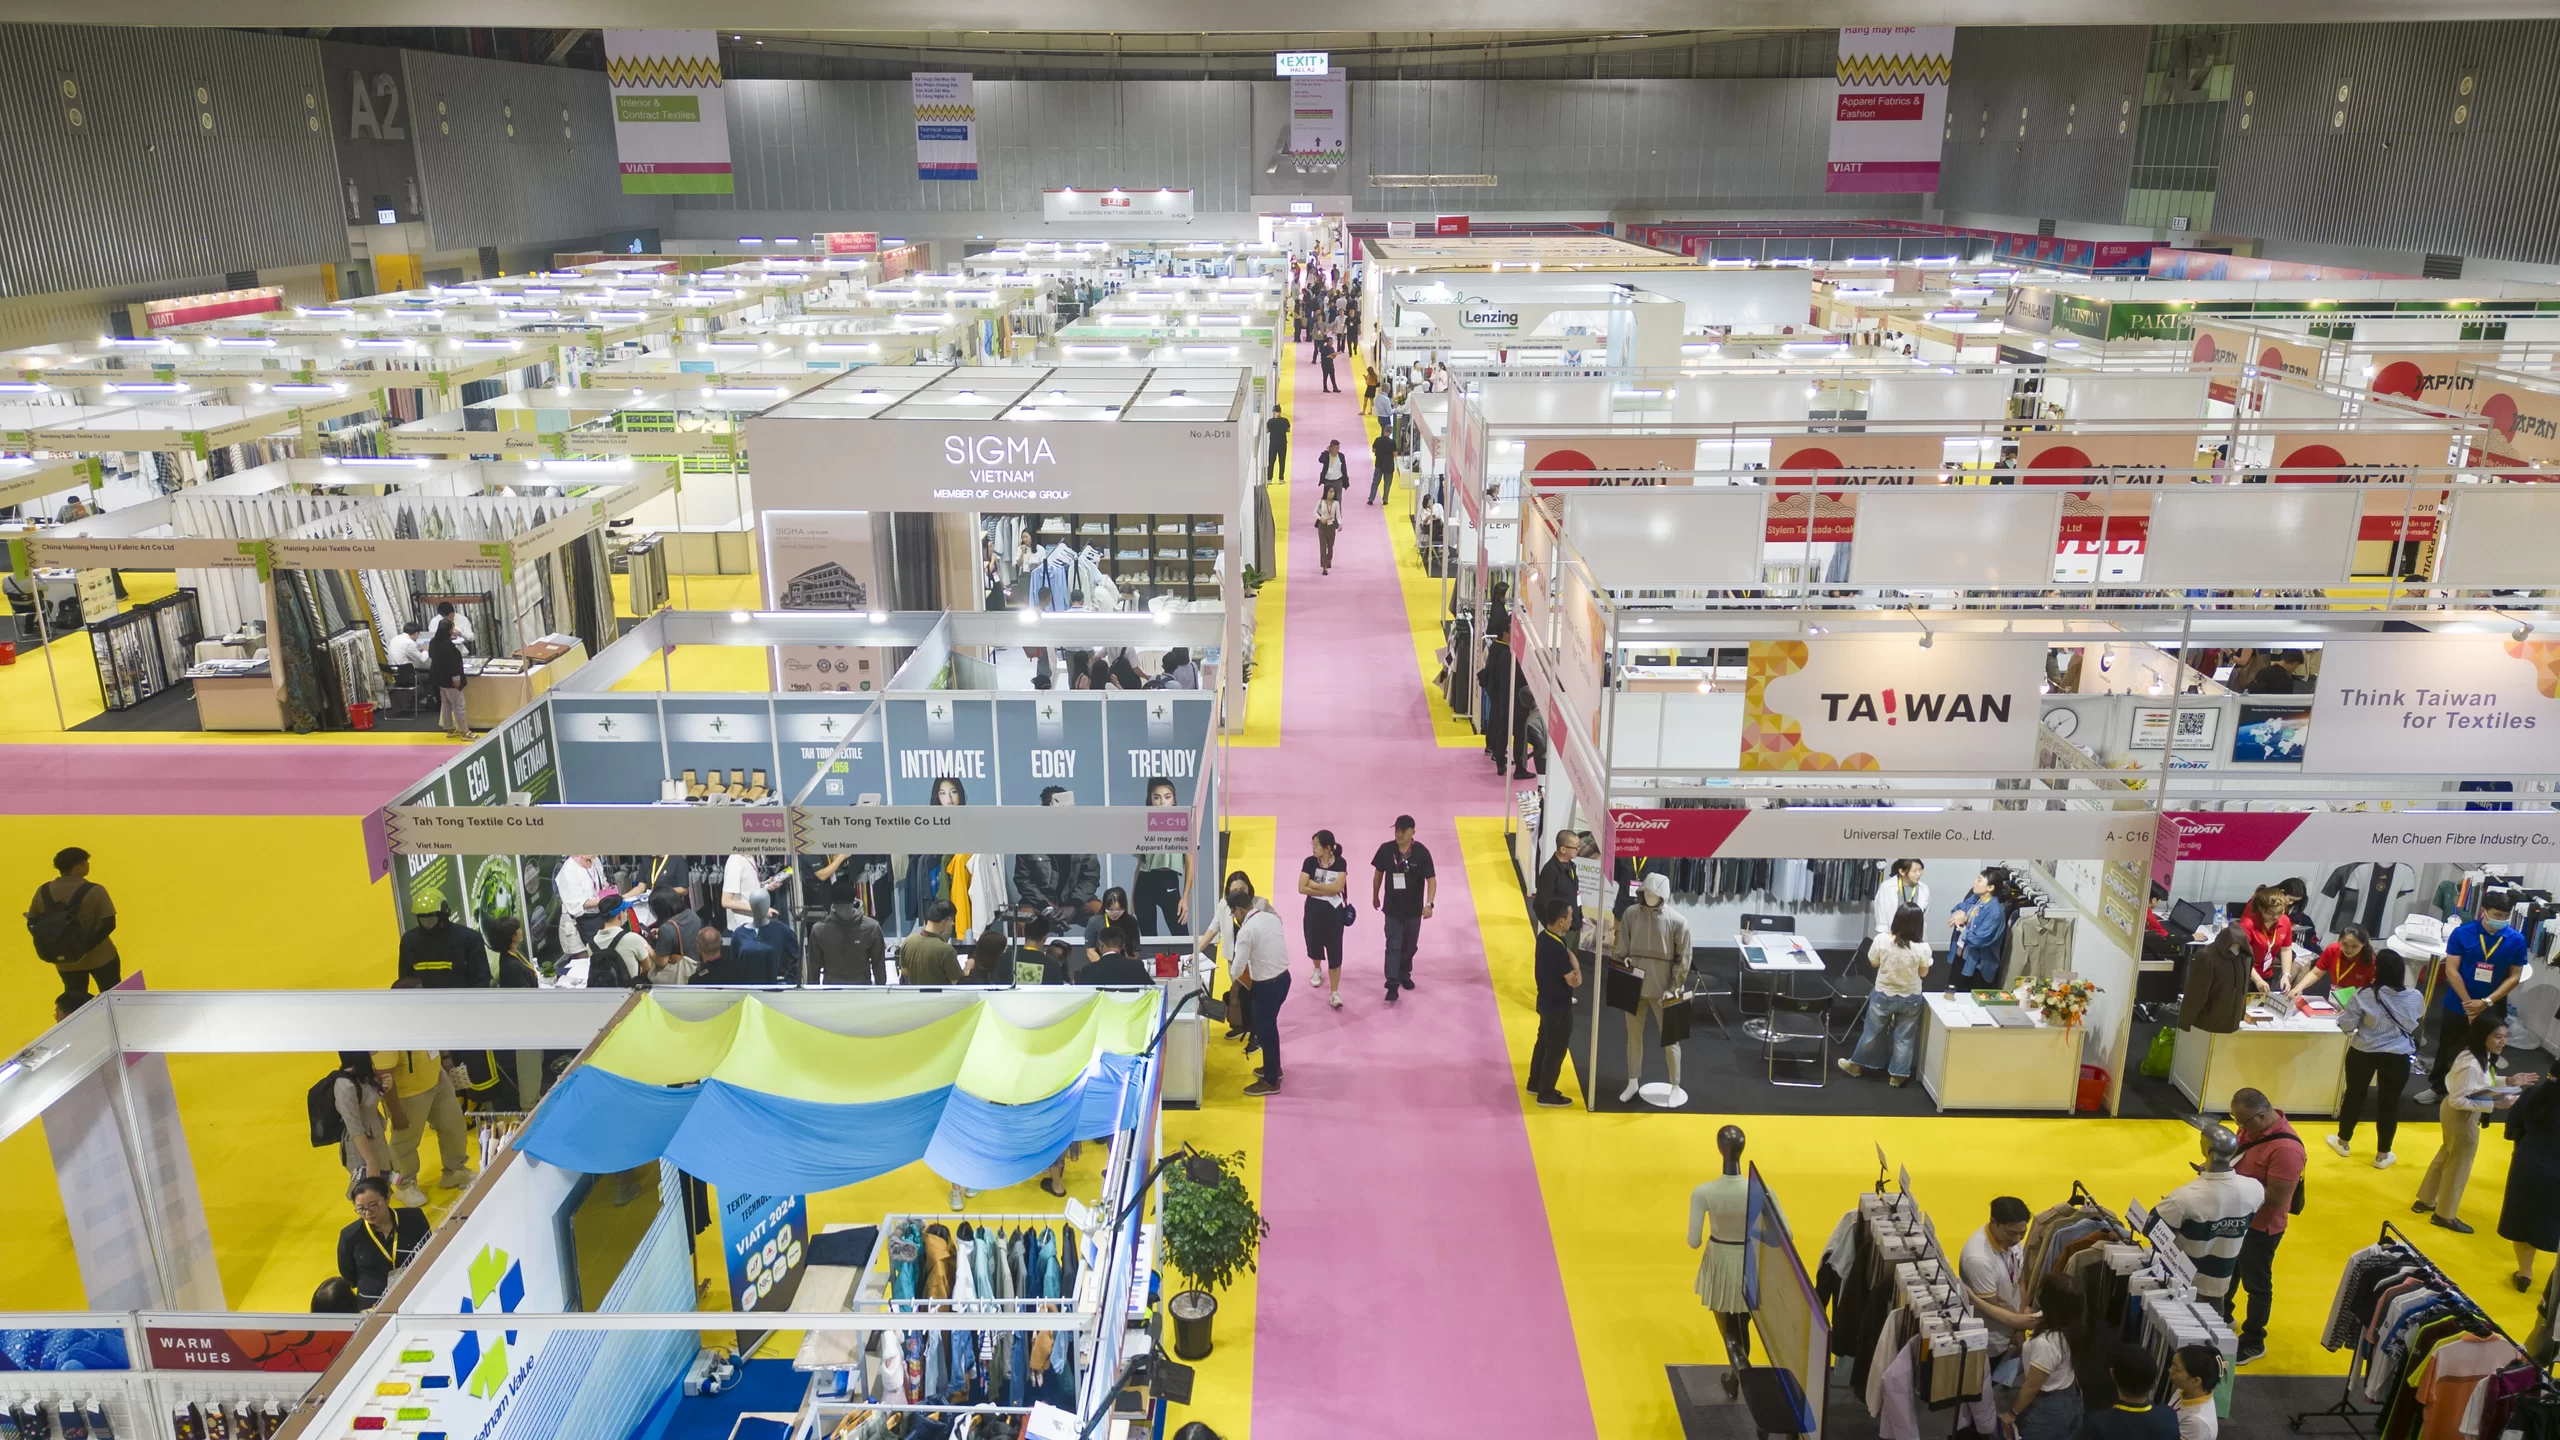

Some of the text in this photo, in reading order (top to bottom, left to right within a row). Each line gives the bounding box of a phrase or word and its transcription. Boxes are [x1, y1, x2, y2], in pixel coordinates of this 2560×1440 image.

[1286, 56, 1317, 66] EXIT
[350, 70, 405, 140] A2
[620, 98, 660, 108] Interior &
[1841, 96, 1920, 108] Apparel Fabrics &
[622, 110, 696, 120] Contract Textiles
[1840, 108, 1875, 118] Fashion
[625, 164, 655, 173] VIATT
[1833, 163, 1862, 172] VIATT
[380, 212, 394, 220] EXIT
[2020, 301, 2050, 320] THAILAND
[2061, 306, 2101, 327] PAKISTAN
[152, 314, 175, 325] VIATT
[1465, 310, 1518, 325] Lenzing
[2212, 348, 2238, 362] JAPAN
[2413, 374, 2474, 392] JAPAN
[2508, 412, 2557, 440] JAPAN
[1190, 430, 1231, 438] No.A-D18
[944, 435, 1056, 465] SIGMA
[970, 470, 1034, 483] VIETNAM
[933, 489, 973, 498] MEMBER
[976, 489, 989, 498] OF
[1040, 489, 1071, 498] GROUP
[1767, 526, 1794, 536] Stylem
[2066, 524, 2082, 532] Ltd
[63, 544, 89, 552] Haining
[90, 544, 108, 552] Heng
[283, 545, 308, 553] Haining
[2340, 689, 2497, 707] Think Taiwan
[2403, 712, 2537, 729] for Textiles
[510, 708, 544, 755] MADE IN
[801, 747, 815, 759] TAH
[513, 738, 548, 786] VIETNAM
[832, 762, 849, 773] 1958
[900, 750, 985, 778] INTIMATE
[1031, 750, 1076, 778] EDGY
[1128, 749, 1196, 778] TRENDY
[465, 755, 490, 801] ECO
[413, 816, 544, 829] Tah Tong Textile Co Ltd
[745, 818, 782, 828] A C18
[820, 816, 951, 828] Tah Tong Textile Co Ltd
[1150, 818, 1186, 827] A C18
[1616, 818, 1670, 830] TAIWAN
[1844, 828, 1994, 842] Universal Textile Co., Ltd.
[2106, 831, 2149, 842] A C16
[2372, 833, 2555, 847] Men Chuen Fibre Industry Co.,
[732, 845, 757, 853] Apparel
[1136, 844, 1162, 852] Apparel
[1578, 864, 1601, 874] UNICO
[736, 1195, 795, 1256] VIATT 2024
[160, 1337, 212, 1349] WARM
[185, 1351, 230, 1363] HUES
[509, 1355, 534, 1396] Value
